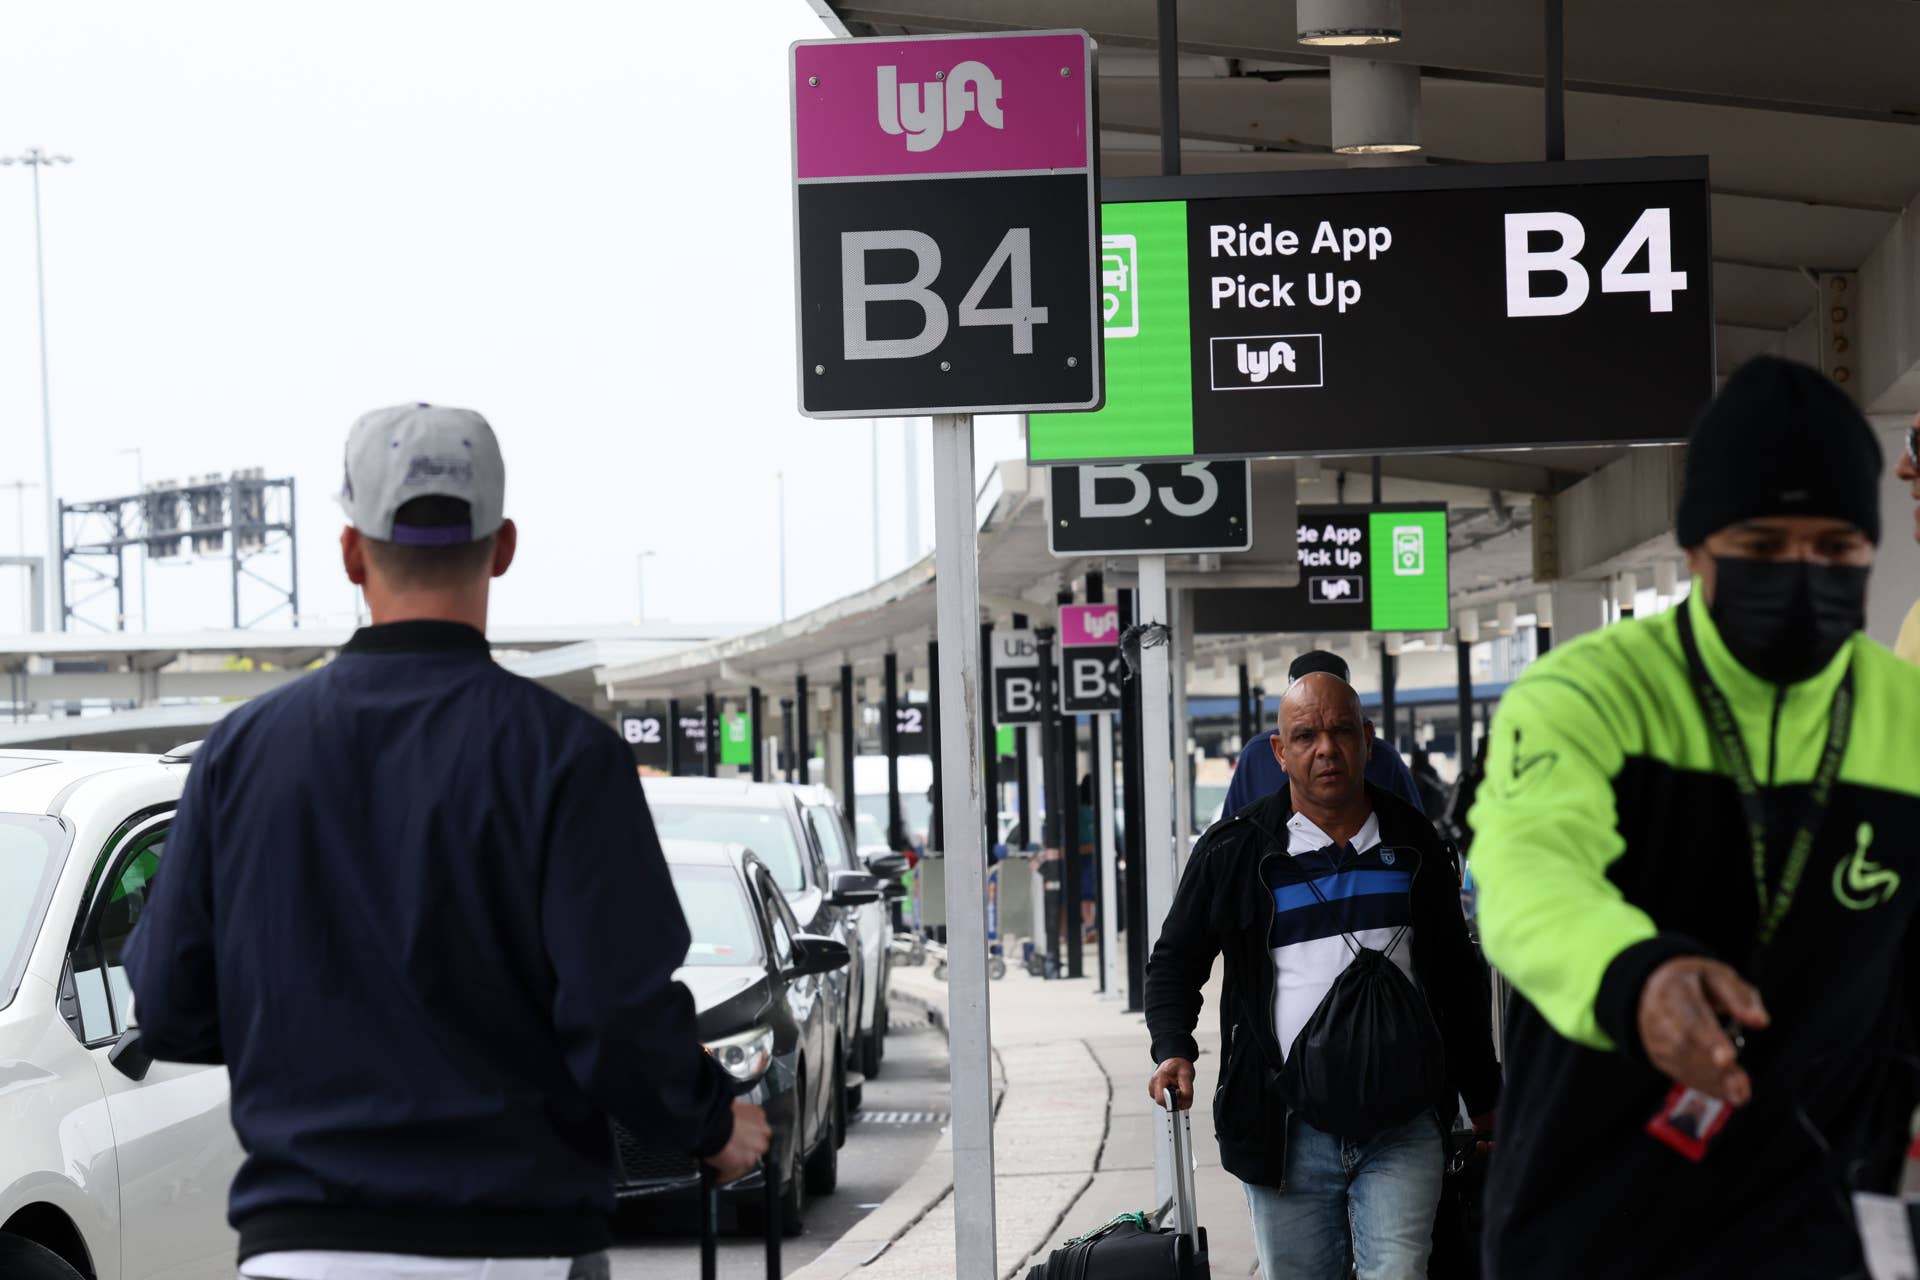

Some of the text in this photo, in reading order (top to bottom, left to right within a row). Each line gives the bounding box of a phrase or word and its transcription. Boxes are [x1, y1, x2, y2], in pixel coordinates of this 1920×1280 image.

[876, 60, 1004, 152] lyft
[1210, 220, 1392, 261] Ride App
[1503, 207, 1688, 318] B4
[840, 227, 1049, 361] B4
[1211, 272, 1362, 313] Pick Up
[1236, 341, 1296, 382] lyft
[1078, 461, 1219, 519] B3
[1322, 524, 1362, 545] App
[1334, 548, 1362, 569] Up
[623, 718, 661, 744] B2
